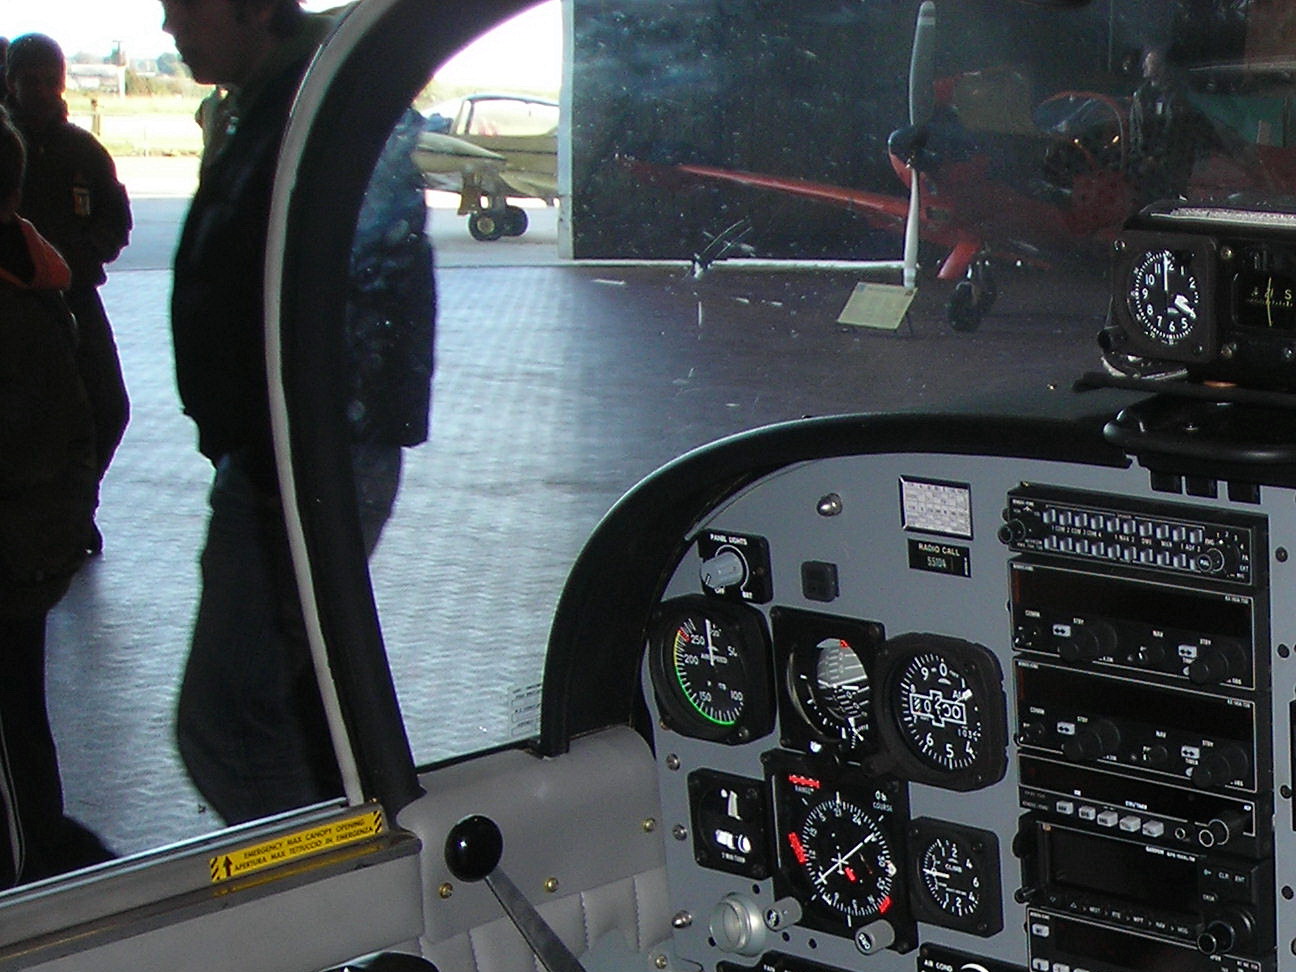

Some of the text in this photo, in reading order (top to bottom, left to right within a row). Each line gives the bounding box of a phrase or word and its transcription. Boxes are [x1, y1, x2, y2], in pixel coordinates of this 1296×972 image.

[1145, 273, 1155, 286] 10
[710, 533, 727, 544] PANEL
[918, 542, 961, 557] RADIO CALL
[690, 634, 705, 645] 250
[684, 653, 699, 665] 200
[730, 690, 743, 702] 100
[243, 819, 365, 859] EMERGENCY MAX CANOPY OPENING
[234, 826, 374, 872] APERTURA MAX TETTUCCIO IN EMERGENZA
